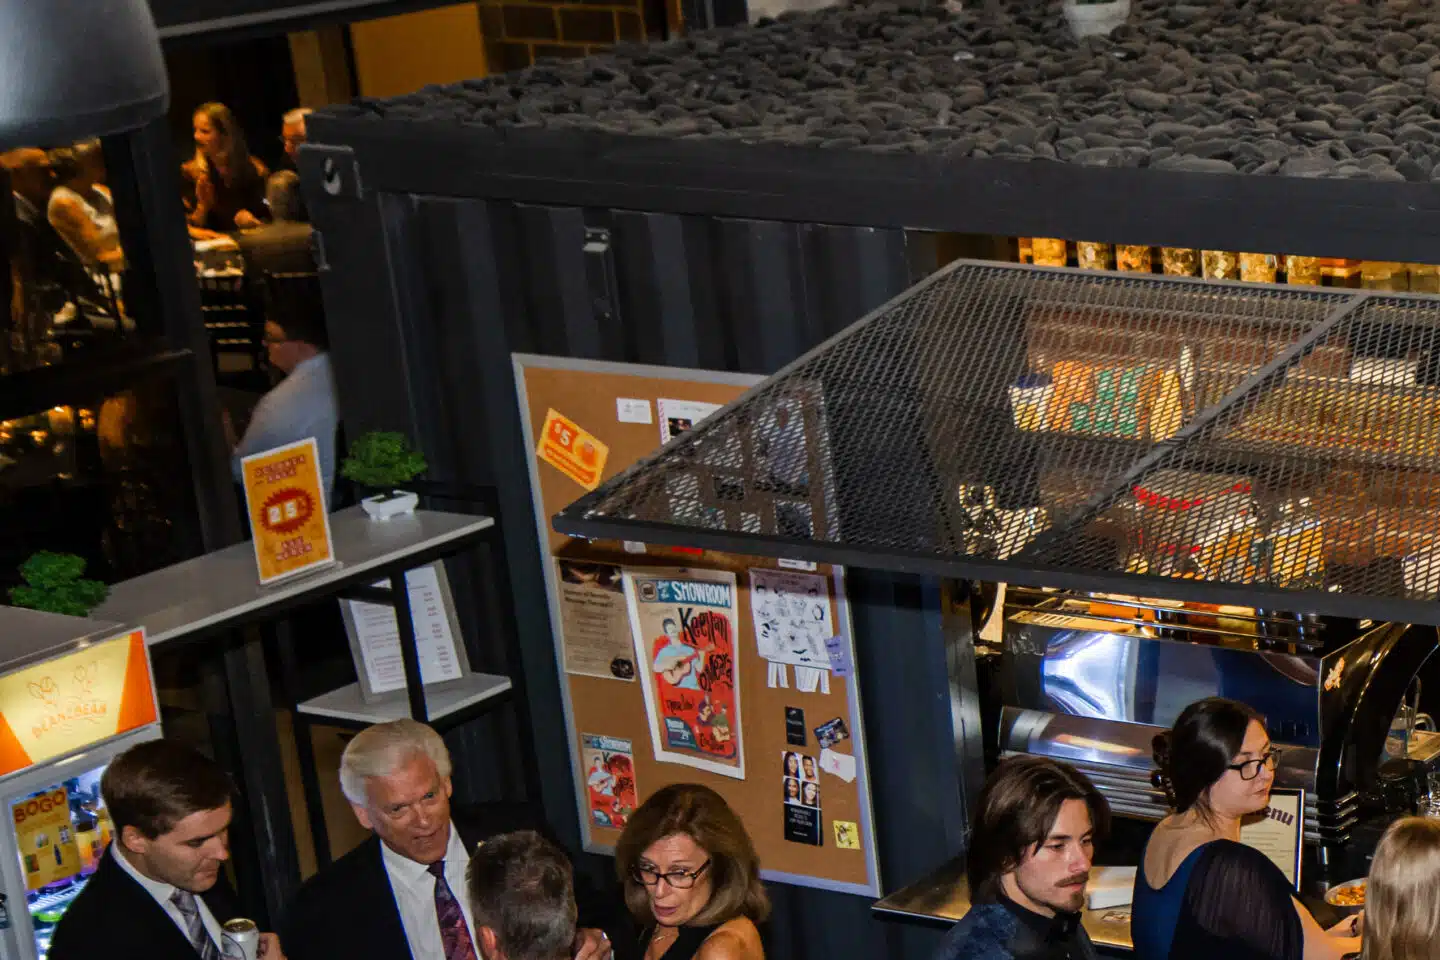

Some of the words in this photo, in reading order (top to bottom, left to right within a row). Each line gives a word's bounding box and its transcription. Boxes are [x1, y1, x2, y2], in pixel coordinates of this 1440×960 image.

[671, 581, 731, 608] SHOWROOM
[14, 789, 66, 825] BOGO
[1259, 806, 1294, 826] enu
